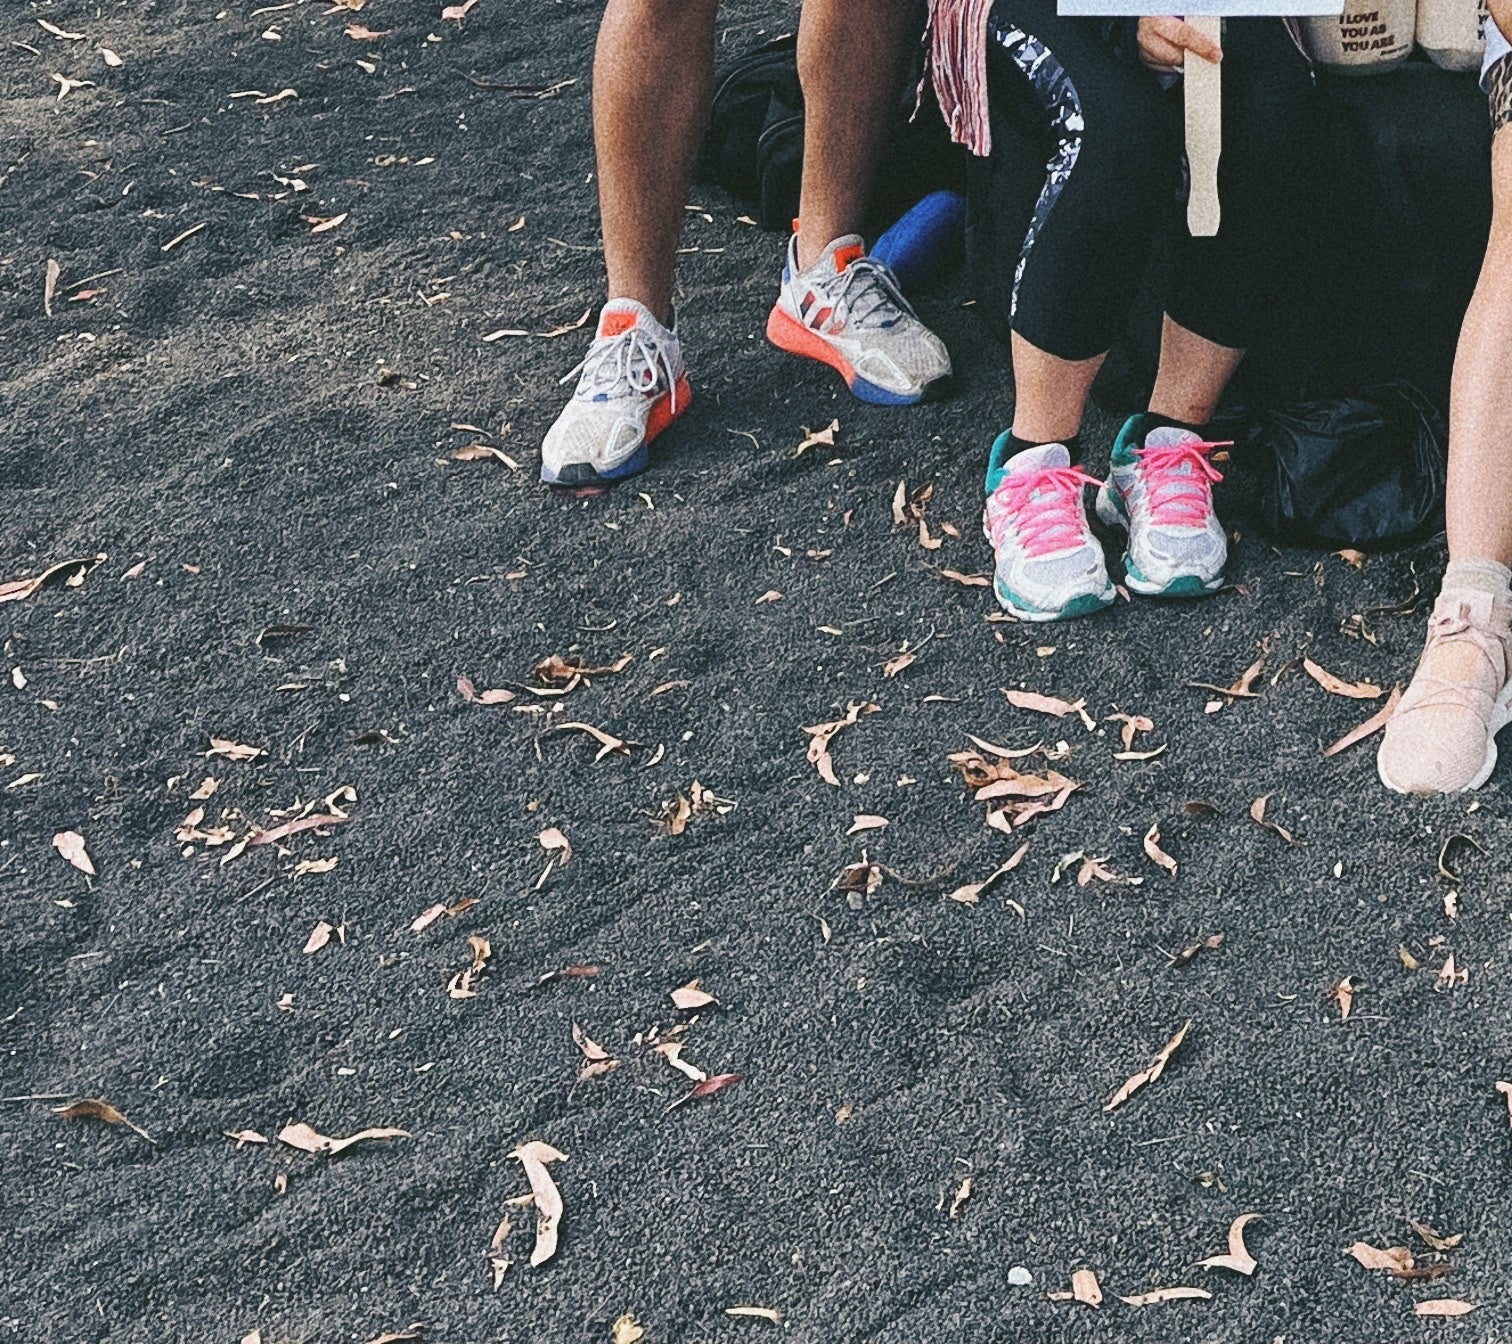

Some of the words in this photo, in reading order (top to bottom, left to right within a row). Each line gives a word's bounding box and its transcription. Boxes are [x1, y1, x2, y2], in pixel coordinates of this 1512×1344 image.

[1346, 11, 1379, 25] LOVE
[1339, 26, 1368, 39] YOU
[1370, 24, 1387, 36] AS
[1341, 40, 1369, 52] YOU
[1370, 35, 1395, 50] ARE
